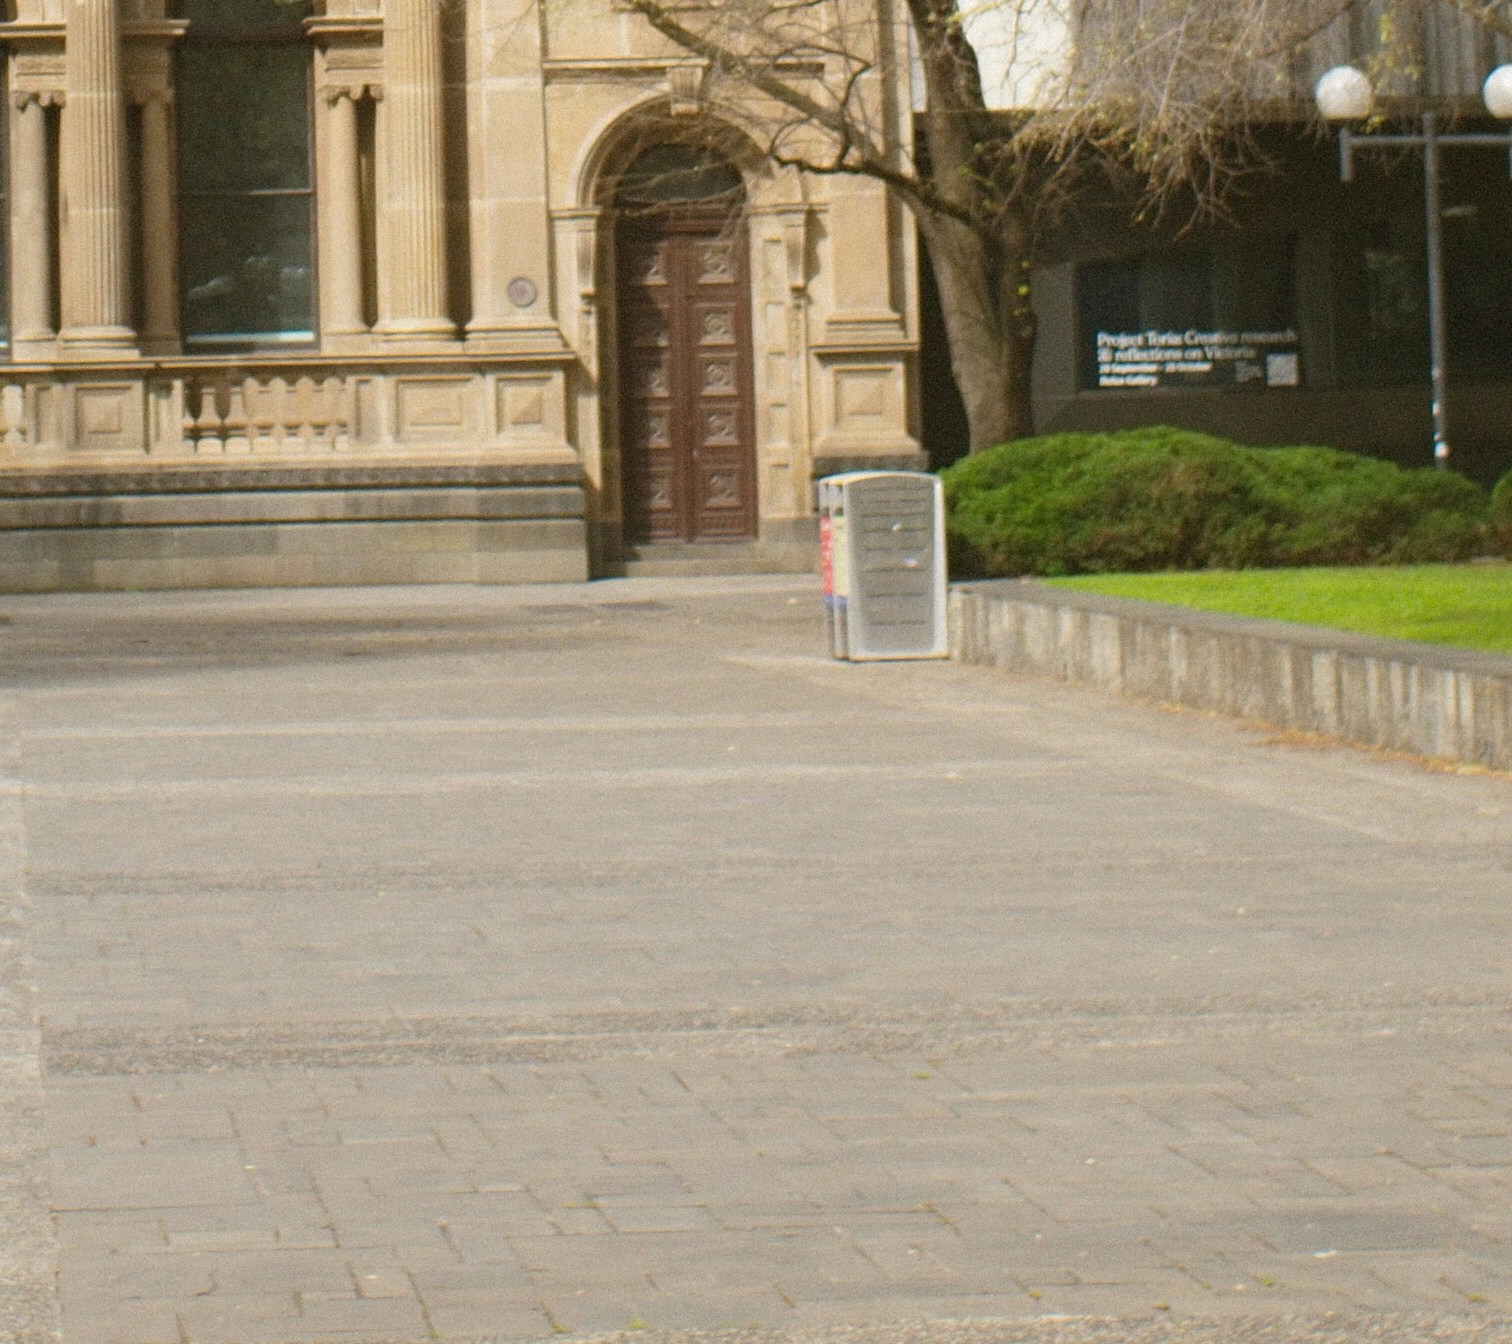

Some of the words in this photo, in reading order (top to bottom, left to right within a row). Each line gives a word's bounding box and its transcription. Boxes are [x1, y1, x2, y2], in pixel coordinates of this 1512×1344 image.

[1098, 331, 1145, 349] Project
[1184, 329, 1238, 346] Creative
[1240, 328, 1297, 345] research
[1115, 347, 1183, 363] reflections
[1184, 348, 1203, 361] on
[1204, 345, 1256, 360] Victoria
